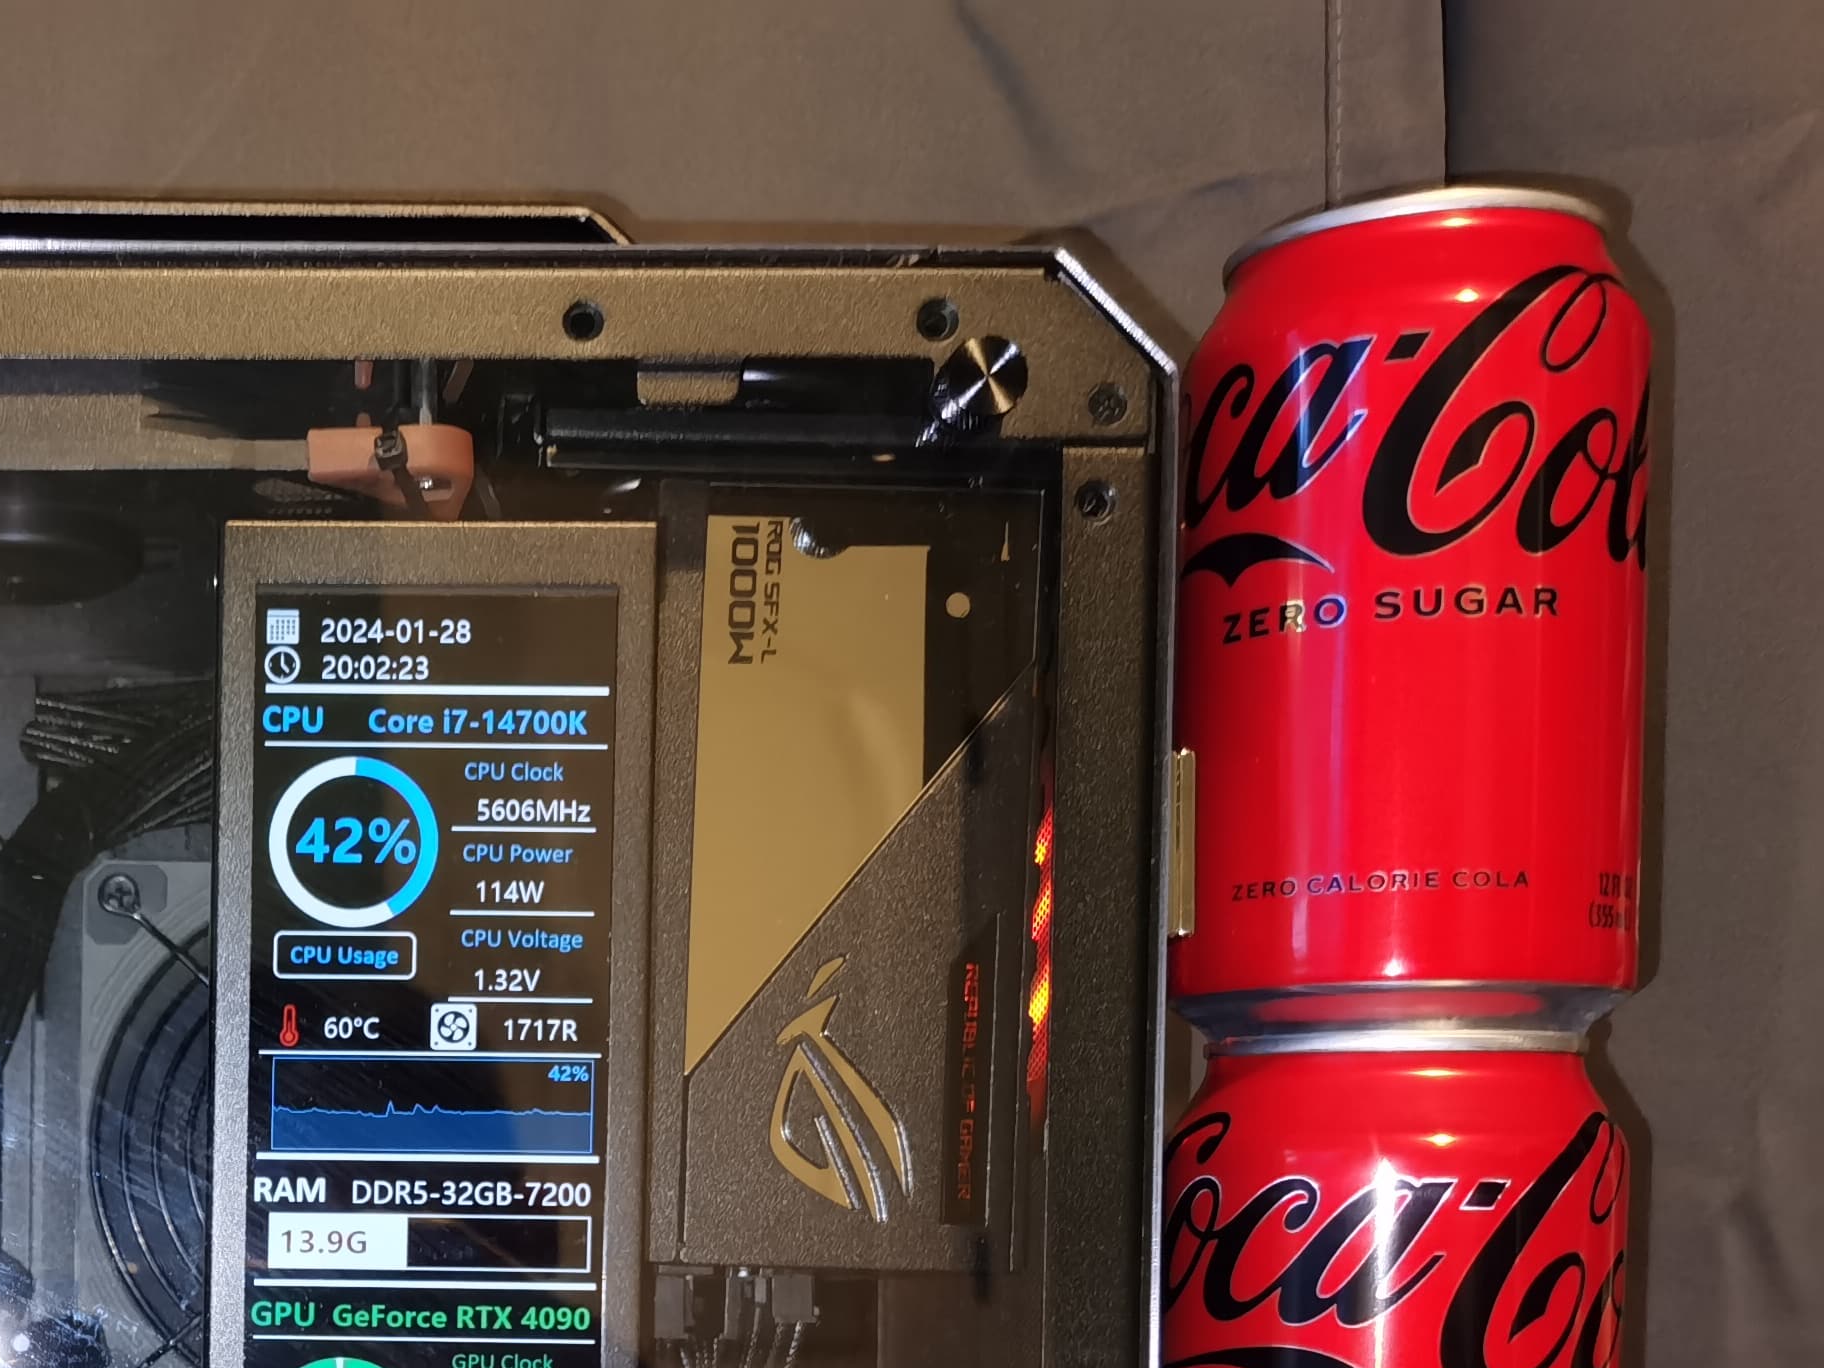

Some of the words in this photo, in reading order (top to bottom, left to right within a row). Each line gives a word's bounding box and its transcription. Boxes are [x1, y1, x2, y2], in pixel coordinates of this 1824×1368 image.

[764, 520, 784, 575] ROG
[727, 520, 760, 665] 1000W
[760, 581, 780, 664] SFX-L
[1222, 594, 1348, 645] ZERO
[1374, 586, 1559, 620] SUGAR
[320, 618, 472, 645] 2024-01-28
[320, 655, 430, 681] 20:02:23
[262, 706, 324, 735] CPU
[368, 708, 433, 735] Core
[442, 709, 588, 736] i7-14700K
[464, 762, 504, 781] CPU
[511, 762, 564, 782] Clock
[476, 799, 591, 824] 5606MHz
[295, 816, 417, 865] 42%
[463, 843, 503, 863] CPU
[510, 843, 573, 864] Power
[476, 881, 545, 904] 114W
[1232, 878, 1297, 902] ZERO
[1307, 870, 1440, 896] CALORIE
[1452, 869, 1530, 889] COLA
[461, 929, 501, 948] CPU
[507, 929, 583, 953] Voltage
[290, 946, 333, 965] CPU
[337, 946, 399, 969] Usage
[473, 969, 541, 992] 1.32V
[323, 1016, 381, 1040] 60°C
[503, 1018, 578, 1043] 1717R
[547, 1065, 589, 1083] 42%
[253, 1176, 327, 1203] RAM
[351, 1180, 591, 1208] DDR5-32GB-7200
[280, 1229, 368, 1255] 13.9G
[250, 1300, 316, 1327] GPU
[332, 1303, 447, 1329] GeForce
[456, 1304, 513, 1330] RTX
[520, 1306, 591, 1332] 4090
